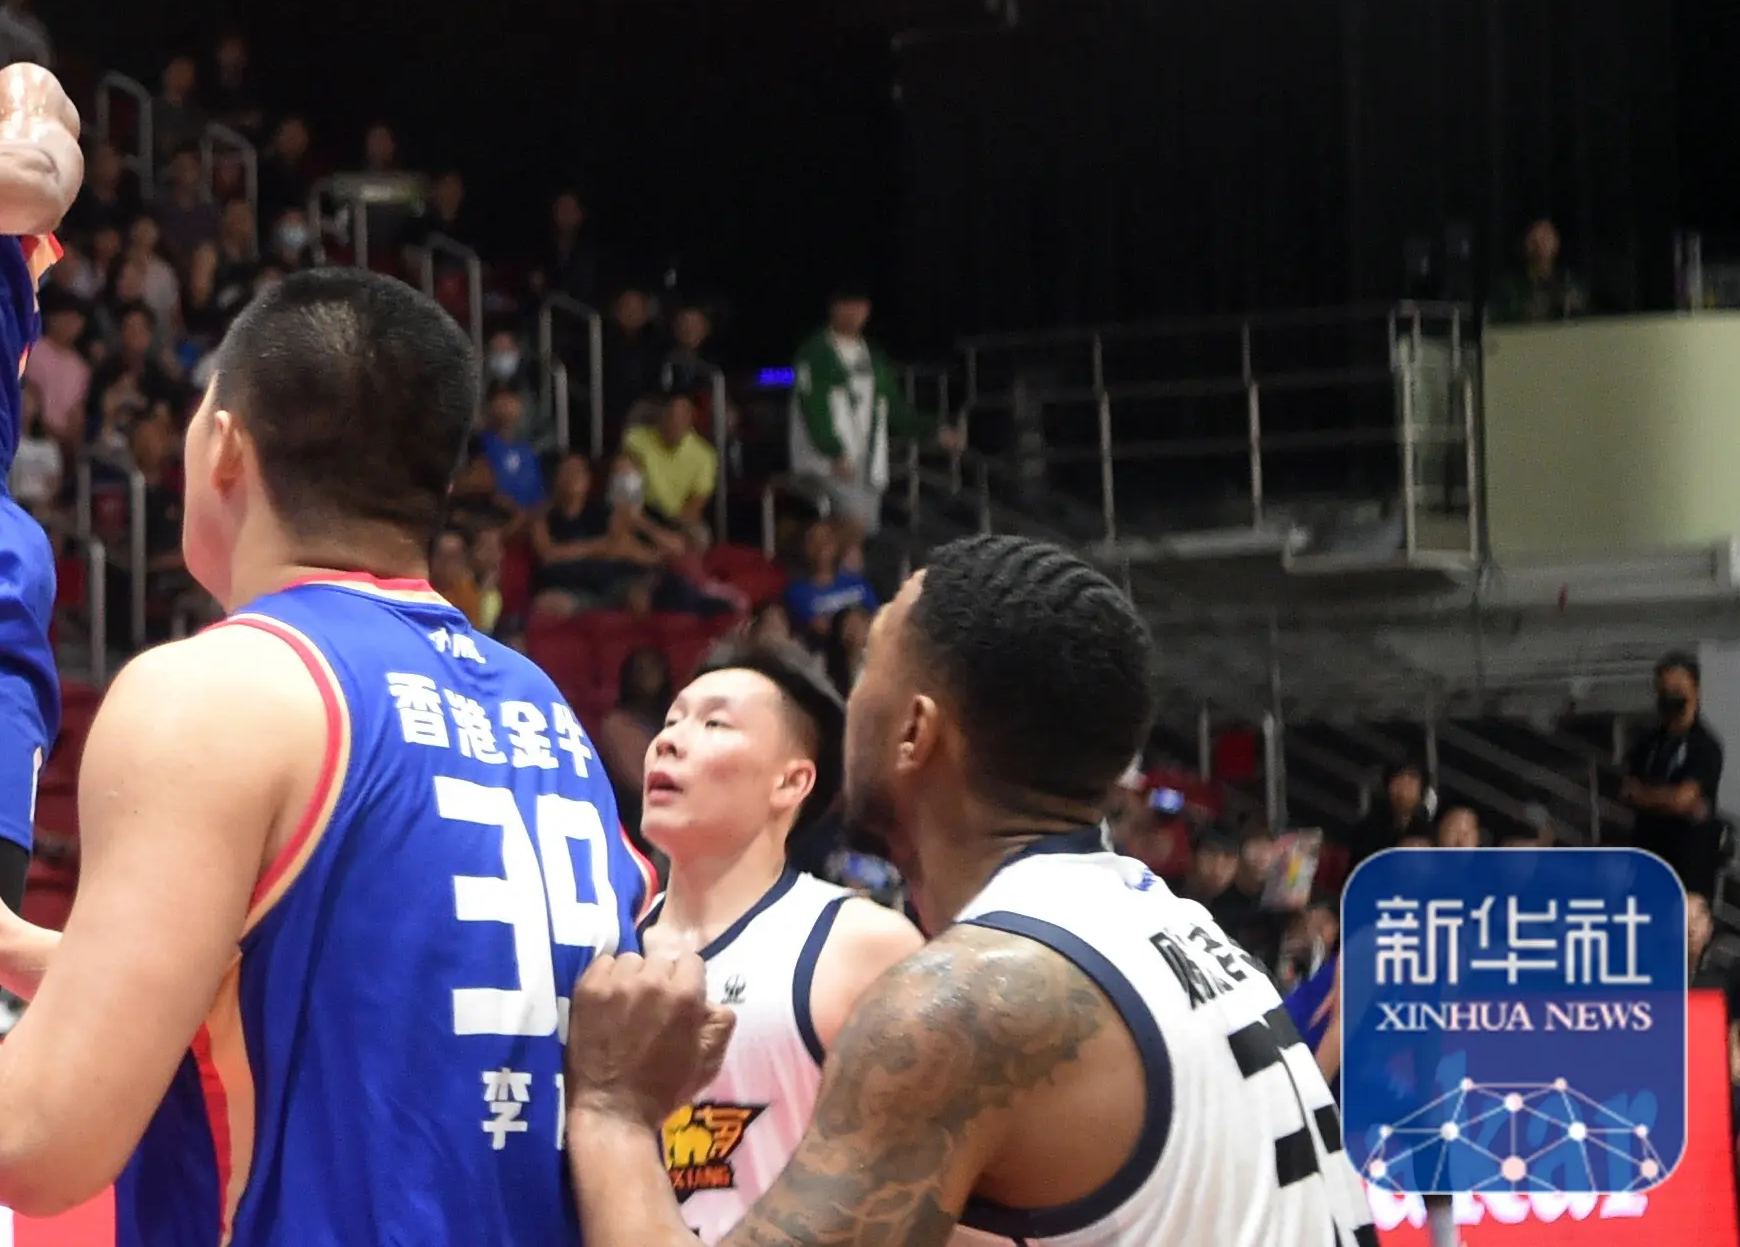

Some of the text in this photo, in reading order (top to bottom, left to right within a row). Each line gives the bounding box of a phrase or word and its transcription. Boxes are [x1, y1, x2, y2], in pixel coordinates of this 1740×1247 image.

[386, 672, 593, 778] 香港金牛
[481, 1067, 566, 1151] 李
